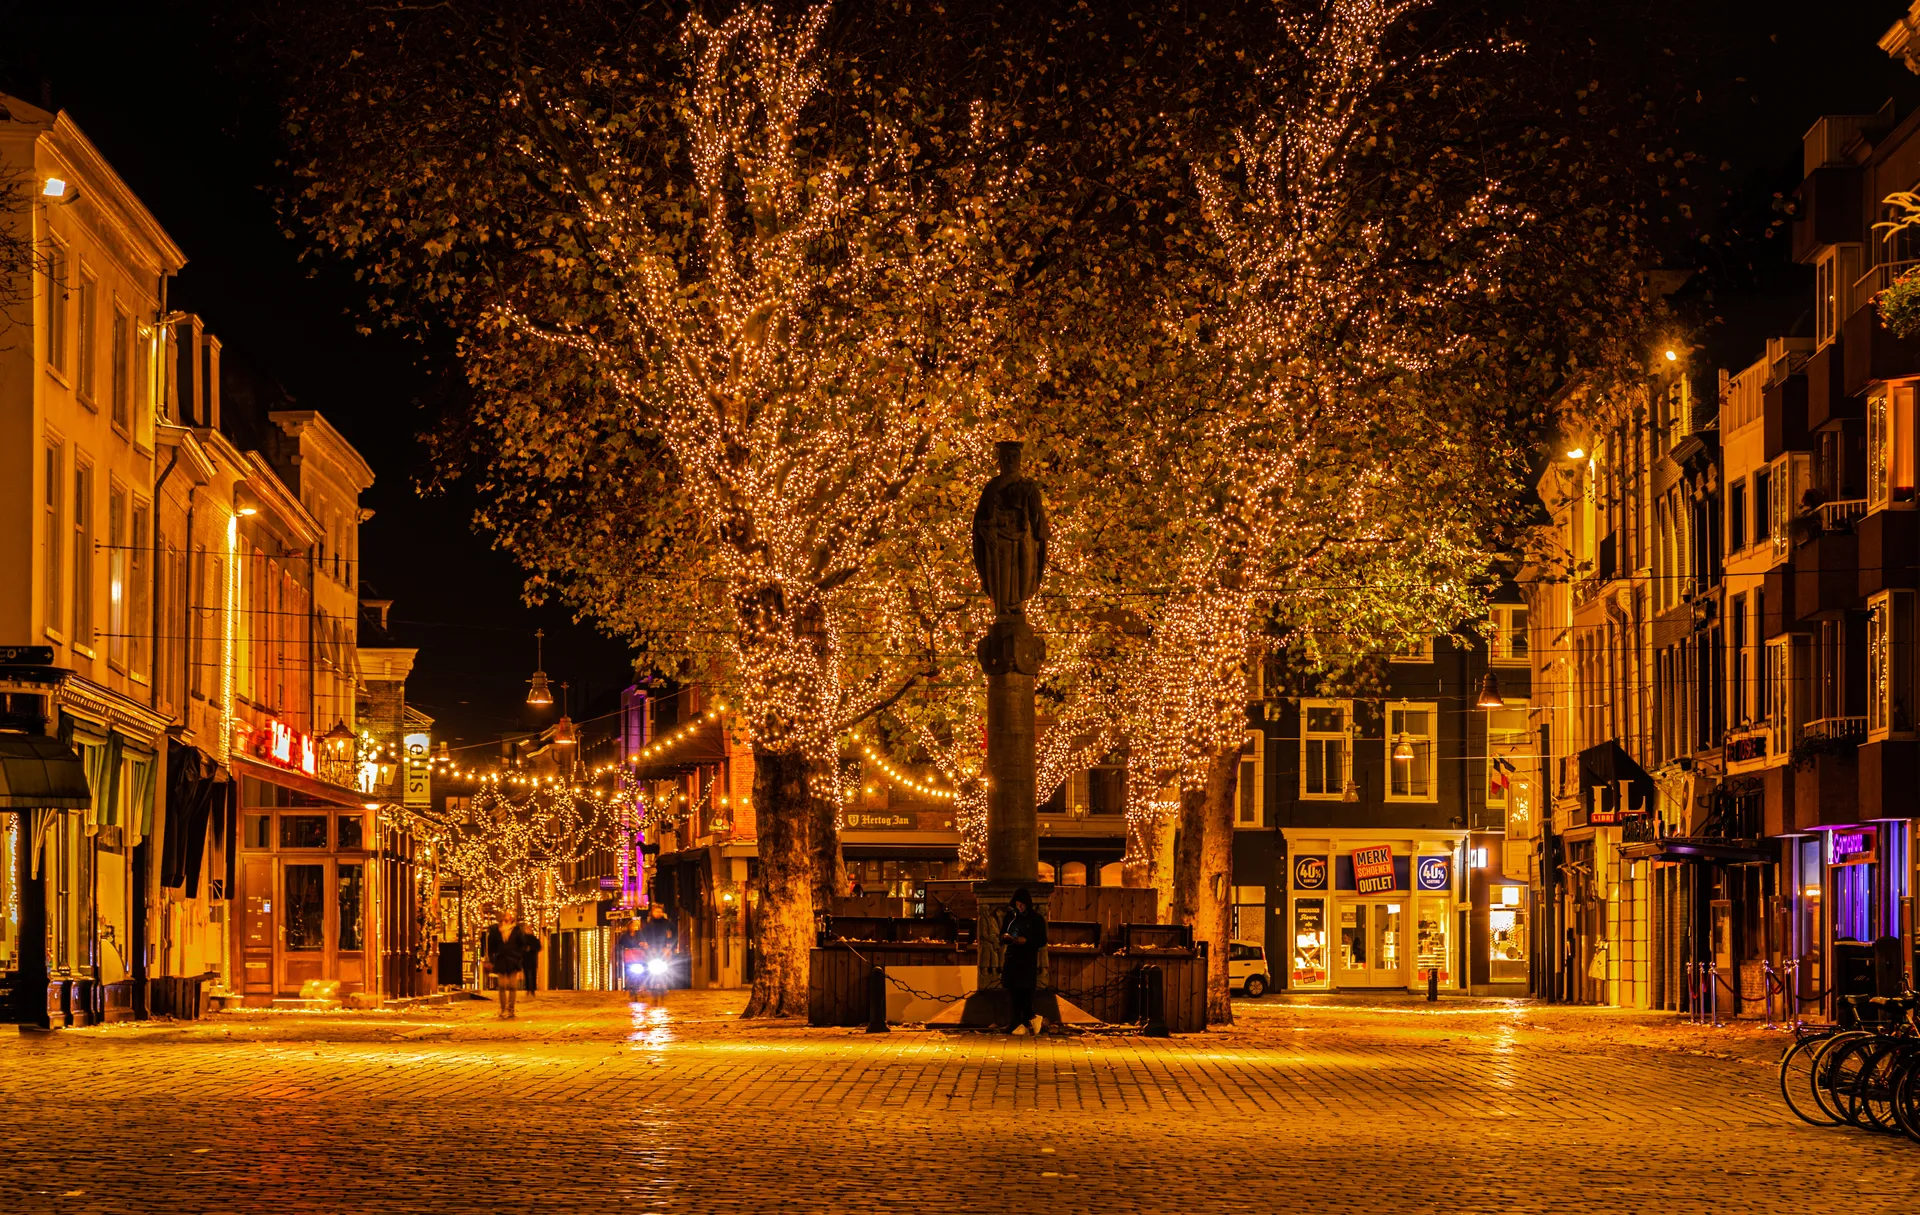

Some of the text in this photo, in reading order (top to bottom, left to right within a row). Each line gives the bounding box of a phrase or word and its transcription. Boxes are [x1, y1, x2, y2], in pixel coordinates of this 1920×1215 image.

[409, 744, 428, 793] ellis
[861, 814, 909, 826] Hertog Jan
[1356, 848, 1389, 866] MERK
[1300, 863, 1321, 879] 40%
[1357, 864, 1391, 878] SCHOENEN
[1423, 864, 1444, 879] 40%
[1359, 876, 1392, 893] OUTLET
